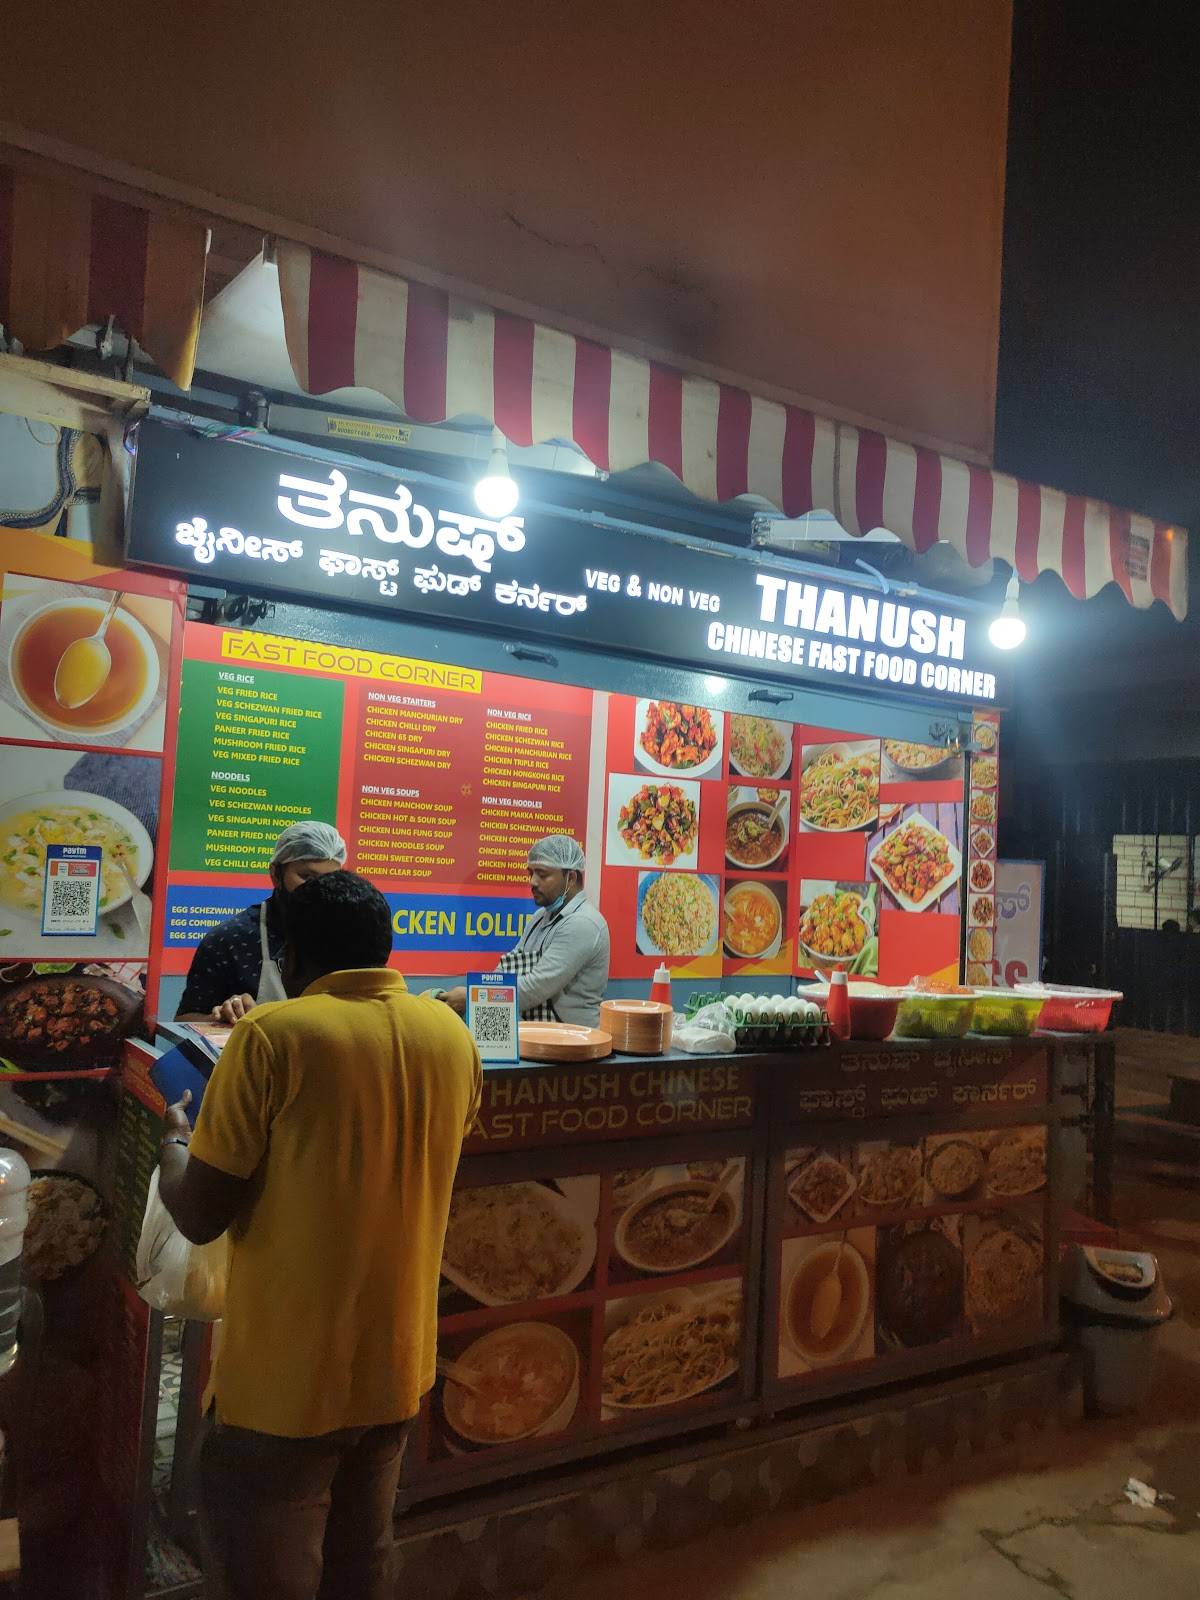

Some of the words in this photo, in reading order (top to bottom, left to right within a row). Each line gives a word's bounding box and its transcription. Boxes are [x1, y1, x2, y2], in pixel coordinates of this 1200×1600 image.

[585, 569, 622, 593] VEG
[626, 575, 642, 597] &
[648, 582, 684, 605] NON
[688, 590, 720, 612] VEG
[755, 574, 966, 660] THANUSH
[228, 637, 297, 664] FAST
[303, 649, 373, 674] FOOD
[380, 662, 476, 690] CORNER
[707, 622, 805, 666] CHINESE
[808, 642, 861, 675] FAST
[863, 652, 916, 685] FOOD
[920, 662, 996, 699] CORNER
[218, 672, 234, 681] VEG
[236, 674, 255, 683] RICE
[217, 686, 233, 696] VEG
[235, 688, 258, 698] FRIED
[259, 691, 278, 700] RICE
[368, 692, 385, 702] NON
[387, 694, 400, 704] VEG
[402, 696, 436, 708] STARTERS
[217, 699, 232, 709] VEG
[234, 701, 279, 714] SCHEZWAN
[281, 707, 303, 717] FRIED
[305, 709, 322, 719] RICE
[367, 706, 398, 717] CHICKEN
[399, 710, 447, 723] MANCHURIAN
[449, 716, 464, 725] DRY
[487, 708, 502, 717] NON
[503, 710, 516, 719] VEG
[517, 712, 532, 721] RICE
[216, 712, 231, 721] VEG
[279, 719, 297, 728] RICE
[366, 718, 397, 729] CHICKEN
[398, 721, 420, 731] CHILLI
[422, 724, 436, 733] DRY
[215, 725, 245, 736] PANEER
[247, 728, 270, 738] FRIED
[272, 731, 289, 740] RICE
[486, 721, 514, 732] CHICKEN
[515, 724, 533, 734] FRIED
[534, 727, 548, 736] RICE
[365, 730, 396, 740] CHICKEN
[408, 734, 423, 743] DRY
[485, 732, 513, 743] CHICKEN
[514, 736, 549, 747] SCHEZWAN
[550, 740, 565, 749] RICE
[214, 737, 262, 750] MUSHROOM
[264, 742, 287, 752] FRIED
[288, 745, 306, 754] RICE
[364, 742, 395, 752] CHICKEN
[436, 749, 450, 757] DRY
[485, 744, 512, 755] CHICKEN
[514, 747, 557, 759] MANCHURIAN
[558, 752, 573, 761] RICE
[213, 750, 228, 759] VEG
[231, 752, 256, 762] MIXED
[258, 754, 281, 764] FRIED
[282, 757, 300, 766] RICE
[363, 754, 394, 764] CHICKEN
[396, 757, 435, 768] SCHEZWAN
[436, 761, 451, 769] DRY
[484, 755, 512, 765] CHICKEN
[535, 761, 549, 769] RICE
[211, 771, 250, 781] NOODELS
[483, 767, 511, 777] CHICKEN
[551, 773, 565, 782] RICE
[210, 785, 226, 794] VEG
[228, 786, 267, 796] NOODLES
[362, 785, 379, 794] NON
[381, 786, 394, 795] VEG
[396, 788, 420, 797] SOUPS
[483, 779, 510, 788] CHICKEN
[547, 784, 560, 793] RICE
[209, 800, 225, 808] VEG
[227, 801, 272, 812] SCHEZWAN
[274, 804, 312, 814] NOODLES
[361, 798, 392, 808] CHICKEN
[393, 801, 432, 811] MANCHOW
[434, 803, 453, 812] SOUP
[482, 796, 497, 805] NON
[499, 798, 511, 806] VEG
[512, 799, 542, 809] NOODLES
[208, 814, 224, 823] VEG
[360, 812, 391, 822] CHICKEN
[392, 814, 409, 823] HOT
[417, 816, 436, 825] SOUR
[437, 817, 456, 826] SOUP
[481, 809, 509, 818] CHICKEN
[534, 813, 564, 822] NOODLES
[207, 829, 238, 838] PANEER
[240, 831, 263, 840] FRIED
[359, 825, 390, 835] CHICKEN
[391, 827, 411, 836] LUNG
[412, 829, 432, 837] FUNG
[433, 830, 453, 838] SOUP
[480, 821, 508, 831] CHICKEN
[509, 823, 544, 833] SCHEZWAN
[546, 826, 575, 835] NOODLES
[358, 839, 389, 848] CHICKEN
[391, 841, 424, 850] NOODLES
[425, 843, 444, 851] SOUP
[480, 834, 507, 844] CHICKEN
[508, 836, 537, 845] COMBIN
[206, 844, 255, 854] MUSHROOM
[257, 846, 274, 855] FRIE
[479, 847, 506, 856] CHICKEN
[508, 849, 529, 857] SINGA
[205, 858, 221, 867] VEG
[222, 859, 248, 868] CHILLI
[357, 852, 388, 862] CHICKEN
[390, 854, 412, 863] SWEET
[414, 855, 434, 864] CORN
[436, 857, 455, 865] SOUP
[478, 860, 506, 869] CHICKEN
[356, 866, 387, 875] CHICKEN
[389, 868, 411, 876] CLEAR
[412, 869, 432, 877] SOUP
[477, 873, 505, 882] CHICKEN
[506, 874, 531, 882] MANCH
[172, 906, 187, 914] EGG
[189, 906, 234, 915] SCHEZWAN
[392, 909, 456, 936] CKEN
[484, 1073, 619, 1107] HANUSH
[630, 1066, 740, 1097] CHINESE
[468, 1112, 534, 1139] AST
[540, 1104, 629, 1137] FOOD
[636, 1095, 752, 1126] CORNER
